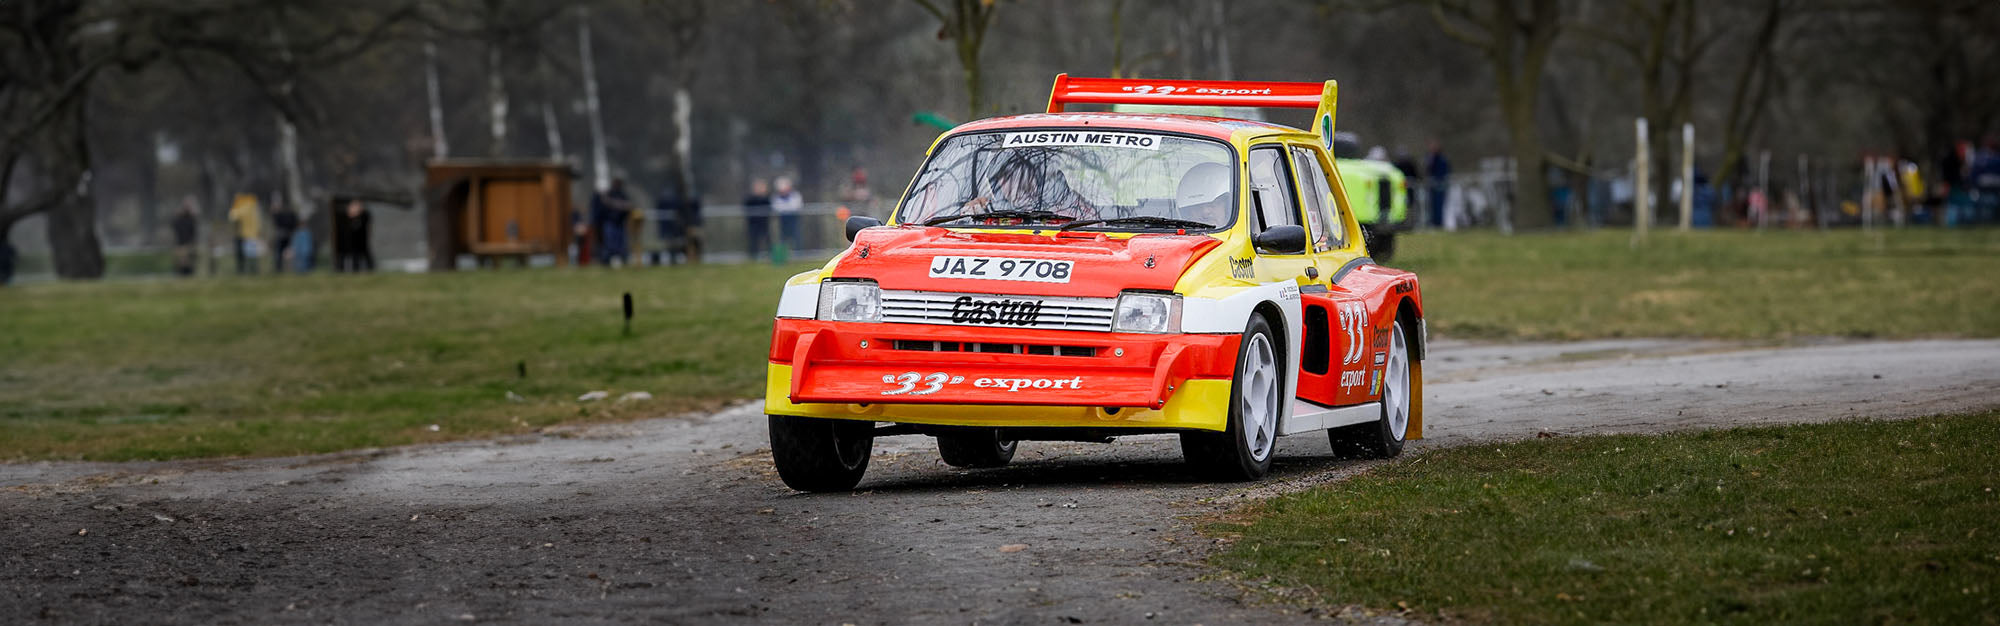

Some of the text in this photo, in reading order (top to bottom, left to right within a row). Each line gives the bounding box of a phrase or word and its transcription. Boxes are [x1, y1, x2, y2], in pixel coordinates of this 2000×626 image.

[1195, 87, 1272, 95] export
[1010, 133, 1153, 146] AUSTIN METRO
[932, 257, 1071, 279] JAZ 9708
[1229, 255, 1256, 278] Castrol
[952, 296, 1044, 326] Castrol
[973, 376, 1084, 392] export
[1341, 365, 1366, 395] export
